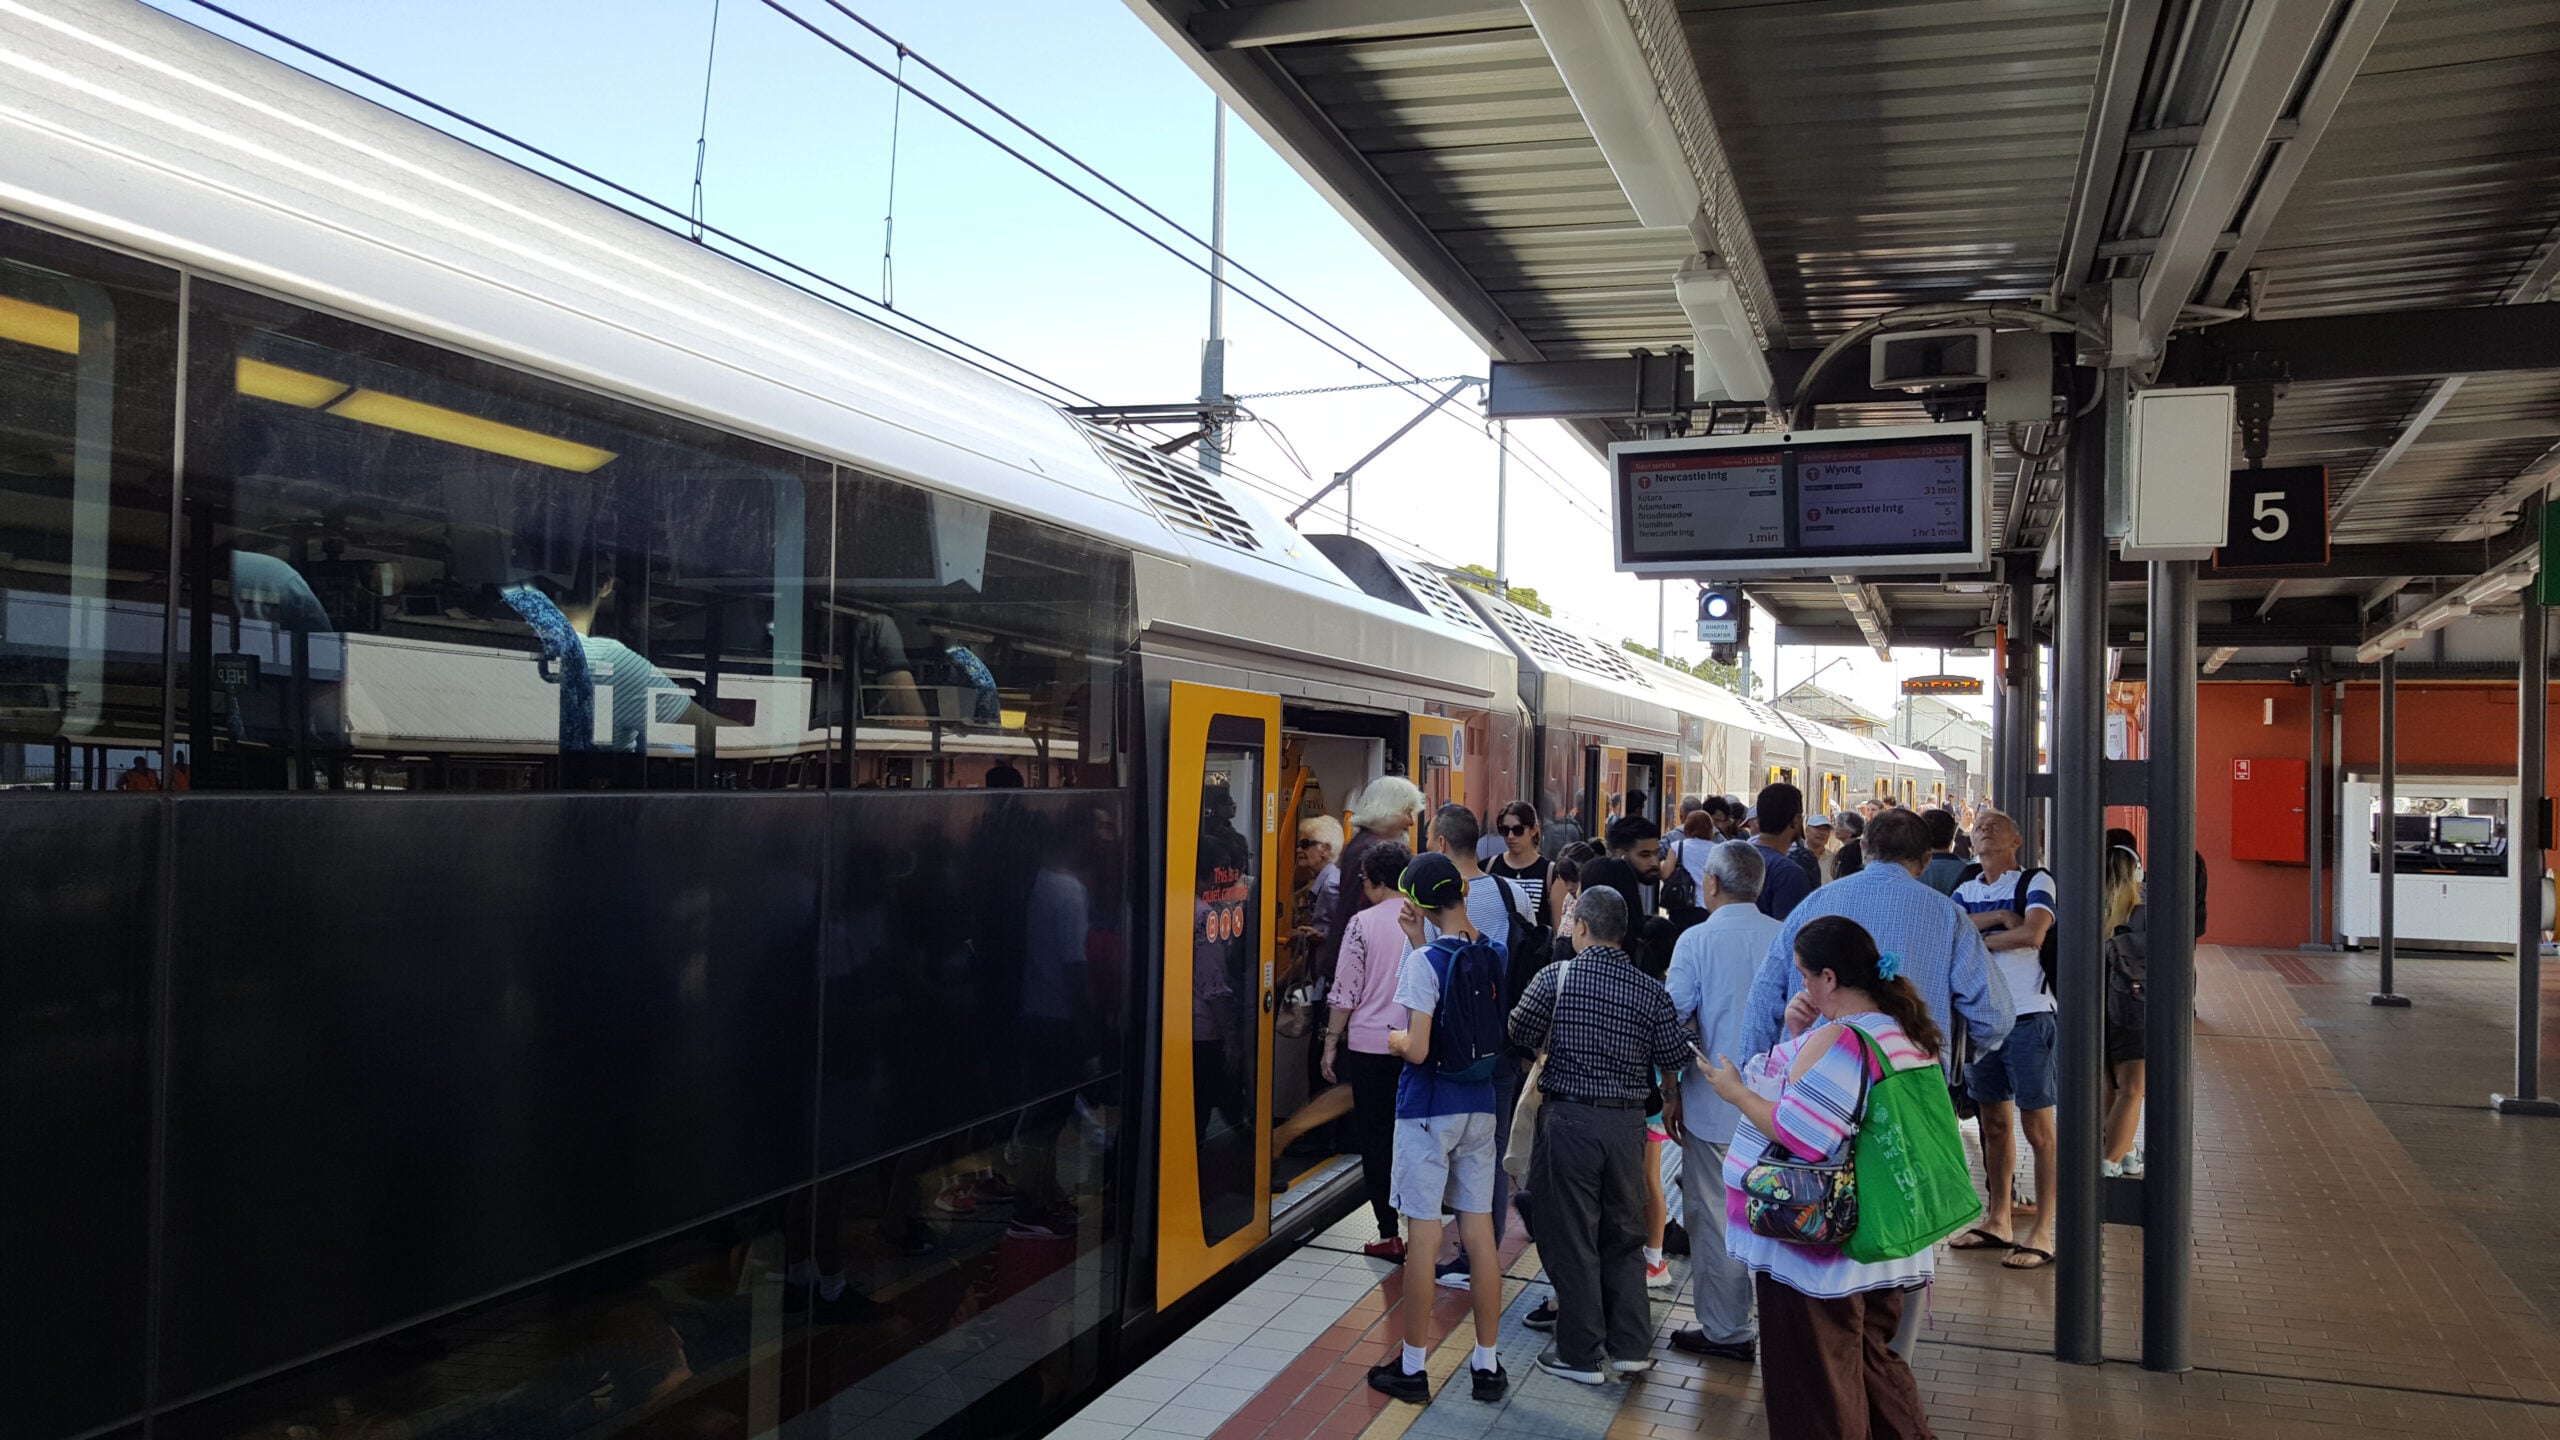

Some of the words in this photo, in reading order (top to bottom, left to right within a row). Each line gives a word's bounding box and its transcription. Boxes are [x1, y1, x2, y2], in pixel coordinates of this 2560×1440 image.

[1825, 464, 1862, 476] Wyong
[1945, 465, 1952, 473] 5
[1655, 472, 1706, 483] Newcastle
[1708, 471, 1728, 481] Intg
[1769, 475, 1777, 485] 5
[1924, 486, 1936, 495] 31
[1938, 486, 1957, 495] min
[1638, 503, 1683, 511] Adamstown
[1826, 504, 1880, 515] Newcastle
[1882, 503, 1904, 515] Intg
[1945, 507, 1952, 516] 5
[1638, 511, 1693, 519] Broadmeadow
[2251, 491, 2290, 541] 5
[1679, 529, 1695, 537] Intg
[1919, 528, 1929, 537] hr
[1931, 528, 1937, 536] 1
[1938, 528, 1957, 536] min
[1748, 533, 1754, 543] 1
[1756, 532, 1778, 542] min
[1214, 867, 1228, 882] This
